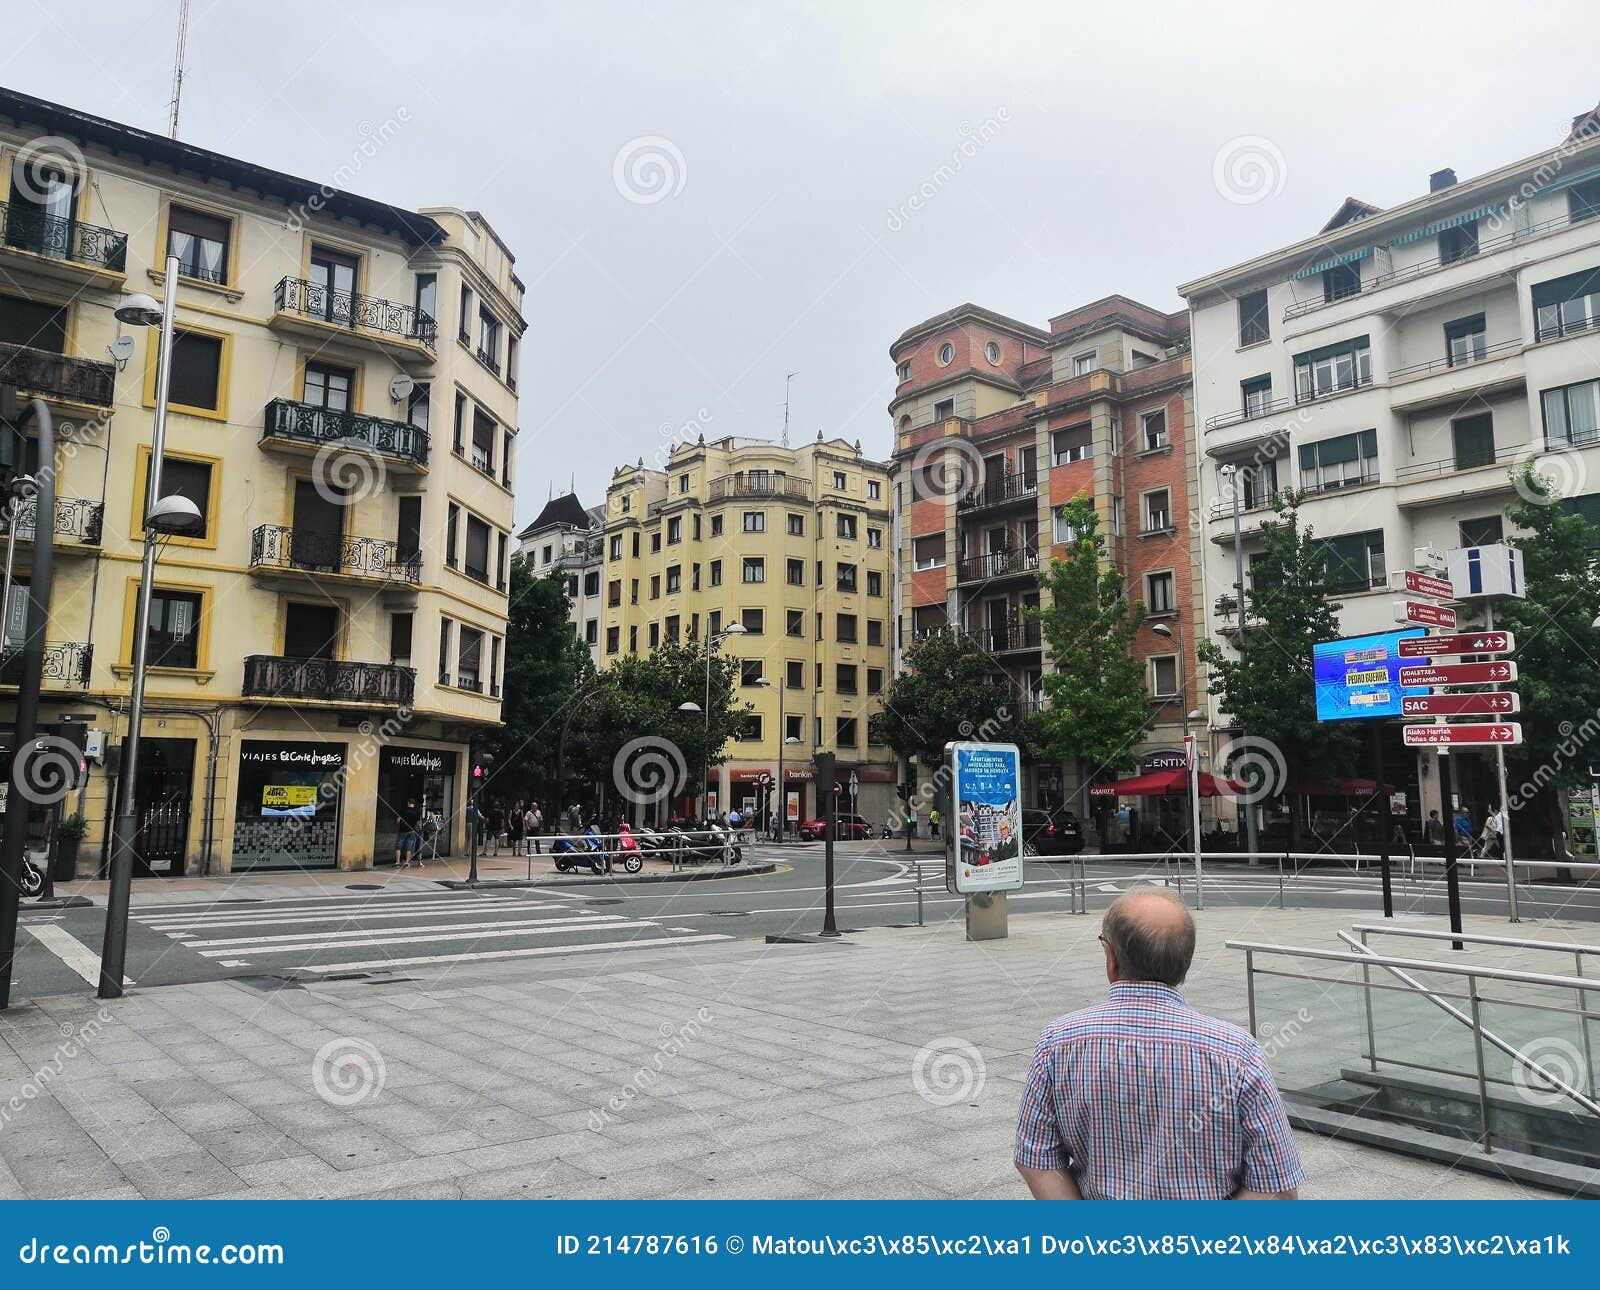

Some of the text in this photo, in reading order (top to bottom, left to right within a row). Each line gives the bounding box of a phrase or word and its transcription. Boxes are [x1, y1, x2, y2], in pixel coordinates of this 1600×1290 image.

[1403, 676, 1448, 684] AYUNTAMIENTO
[1404, 701, 1429, 711] SAC
[241, 752, 278, 762] VIAJES
[391, 756, 409, 766] VIAJES
[789, 770, 813, 779] bankin
